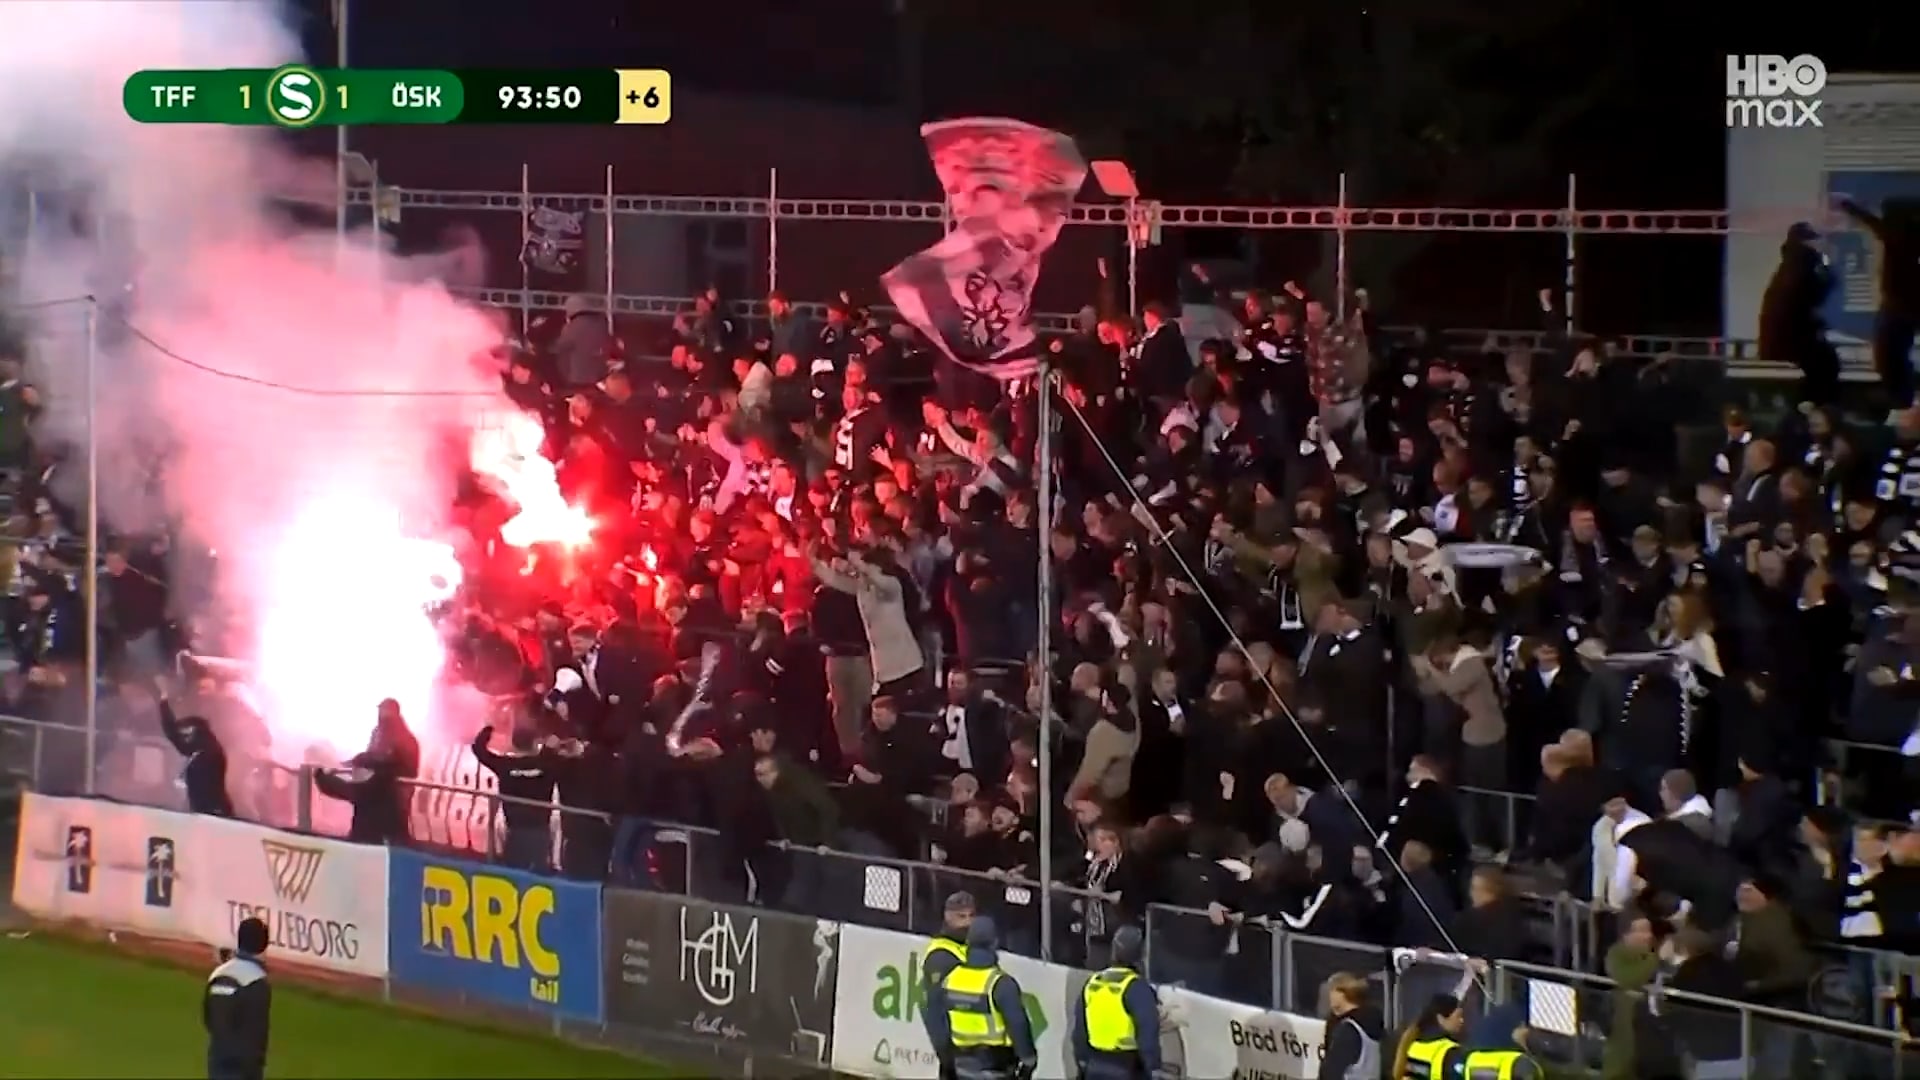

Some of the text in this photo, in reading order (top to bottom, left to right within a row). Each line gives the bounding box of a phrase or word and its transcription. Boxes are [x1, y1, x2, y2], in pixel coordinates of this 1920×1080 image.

[422, 866, 560, 976] RRC
[1229, 1019, 1278, 1054] Bröd
[1281, 1030, 1310, 1060] för
